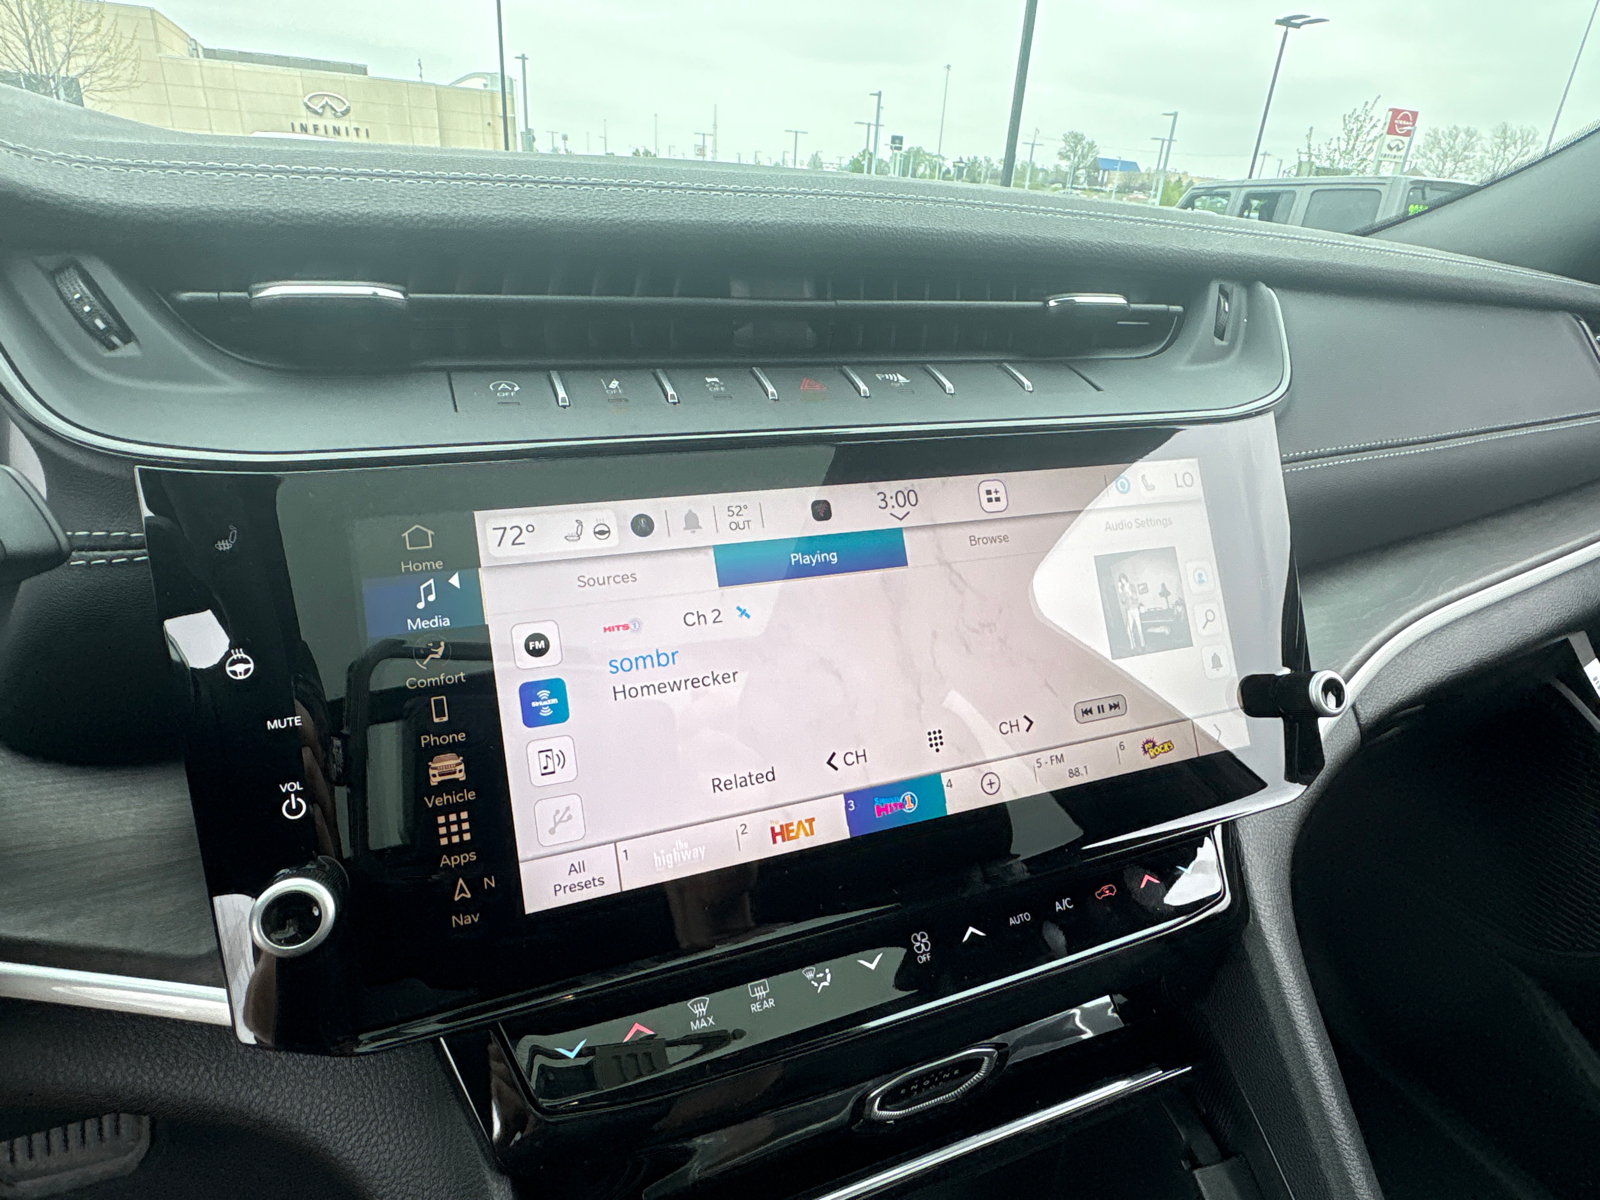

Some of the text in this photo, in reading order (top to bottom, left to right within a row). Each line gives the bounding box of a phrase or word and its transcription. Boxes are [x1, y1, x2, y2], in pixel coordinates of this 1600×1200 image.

[290, 122, 369, 138] INFINITI
[1174, 471, 1194, 488] LO
[876, 488, 919, 510] 3:00
[727, 505, 748, 517] 52°
[729, 519, 752, 531] OUT
[1104, 515, 1173, 532] Audio Settings
[492, 523, 536, 548] 72°
[968, 532, 1010, 548] Browse
[401, 558, 443, 573] Home
[790, 550, 838, 566] Playing
[577, 570, 637, 589] Sources
[407, 615, 450, 630] Media
[682, 609, 723, 627] Ch 2
[529, 640, 546, 650] FM
[608, 648, 679, 675] sombr
[405, 671, 466, 690] Comfort
[612, 668, 739, 701] Homewrecker
[267, 716, 302, 730] MUTE
[998, 719, 1020, 735] CH
[420, 731, 466, 747] Phone
[1119, 741, 1125, 751] 6
[1149, 741, 1174, 758] ROCKS
[843, 749, 867, 767] CH
[1049, 753, 1065, 766] FM
[711, 766, 776, 793] Related
[1068, 765, 1088, 778] 88.1
[279, 781, 303, 793] VOL
[945, 778, 953, 790] 4
[424, 788, 476, 808] Vehicle
[847, 799, 855, 811] 3
[739, 823, 748, 835] 2
[769, 817, 816, 845] HEAT
[439, 851, 477, 868] Apps
[622, 849, 629, 861] 1
[653, 845, 706, 870] highway
[567, 860, 586, 876] All
[483, 876, 496, 889] N
[553, 874, 605, 896] Presets
[1055, 897, 1074, 912] A/C
[451, 912, 480, 928] Nav
[1009, 912, 1031, 926] AUTO
[917, 952, 931, 964] OFF
[750, 998, 776, 1014] REAR
[690, 1015, 715, 1031] MAX
